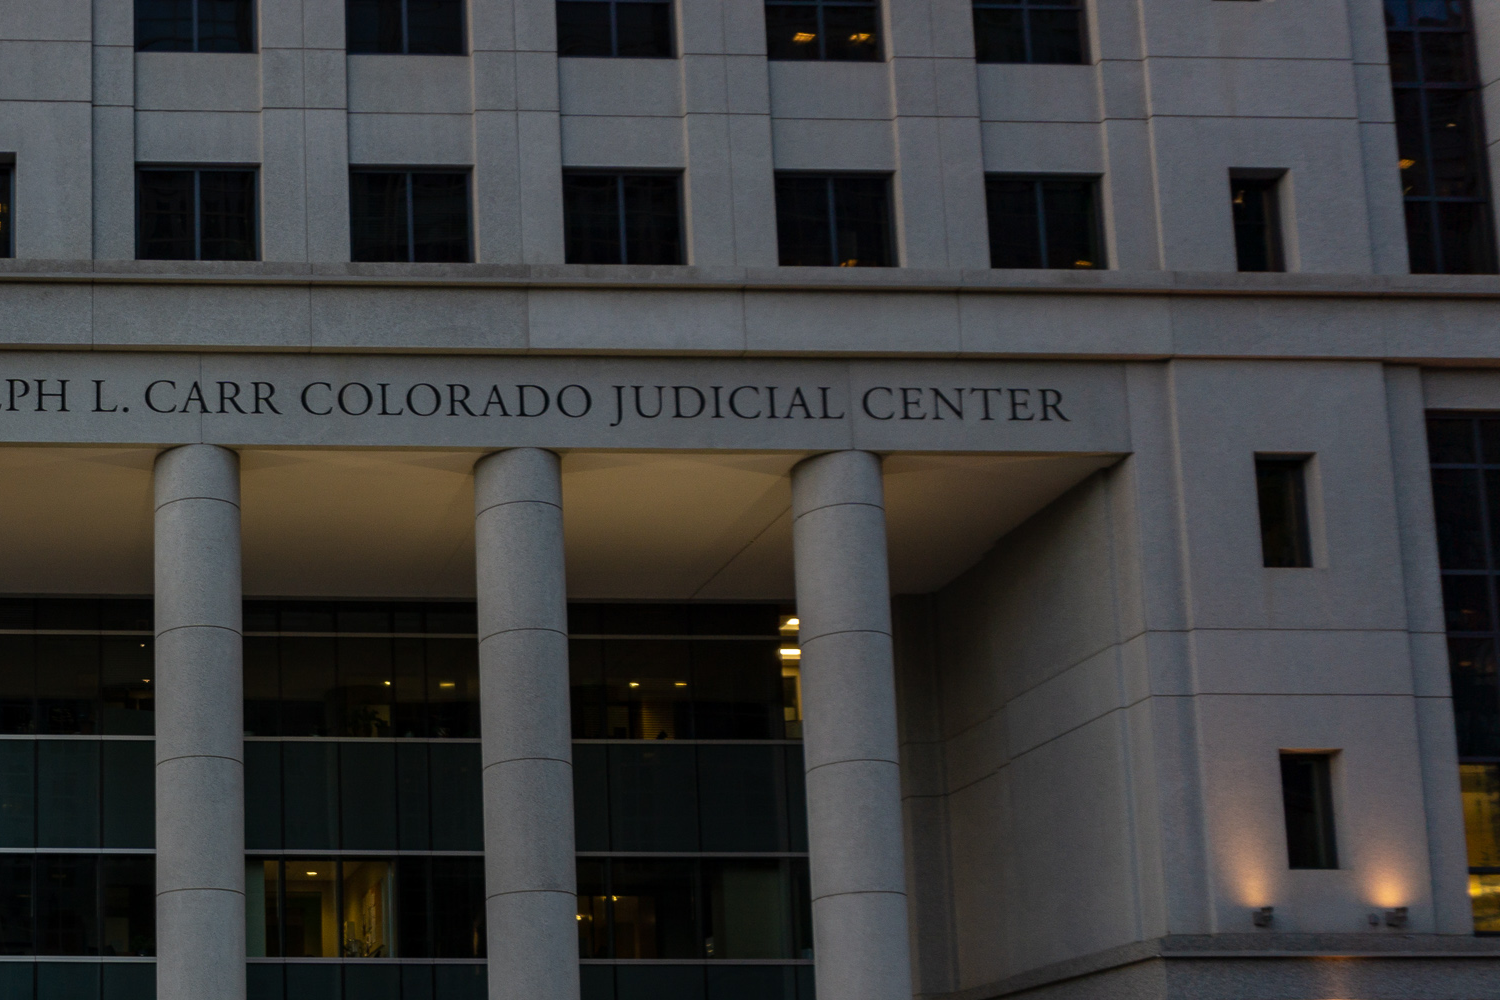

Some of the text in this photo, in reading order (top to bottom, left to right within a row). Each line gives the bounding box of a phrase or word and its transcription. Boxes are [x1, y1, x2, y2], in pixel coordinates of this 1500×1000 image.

[91, 379, 129, 413] L.
[144, 379, 283, 414] CARR
[300, 381, 592, 418] COLORADO
[609, 385, 845, 427] JUDICIAL
[862, 386, 1071, 421] CENTER
